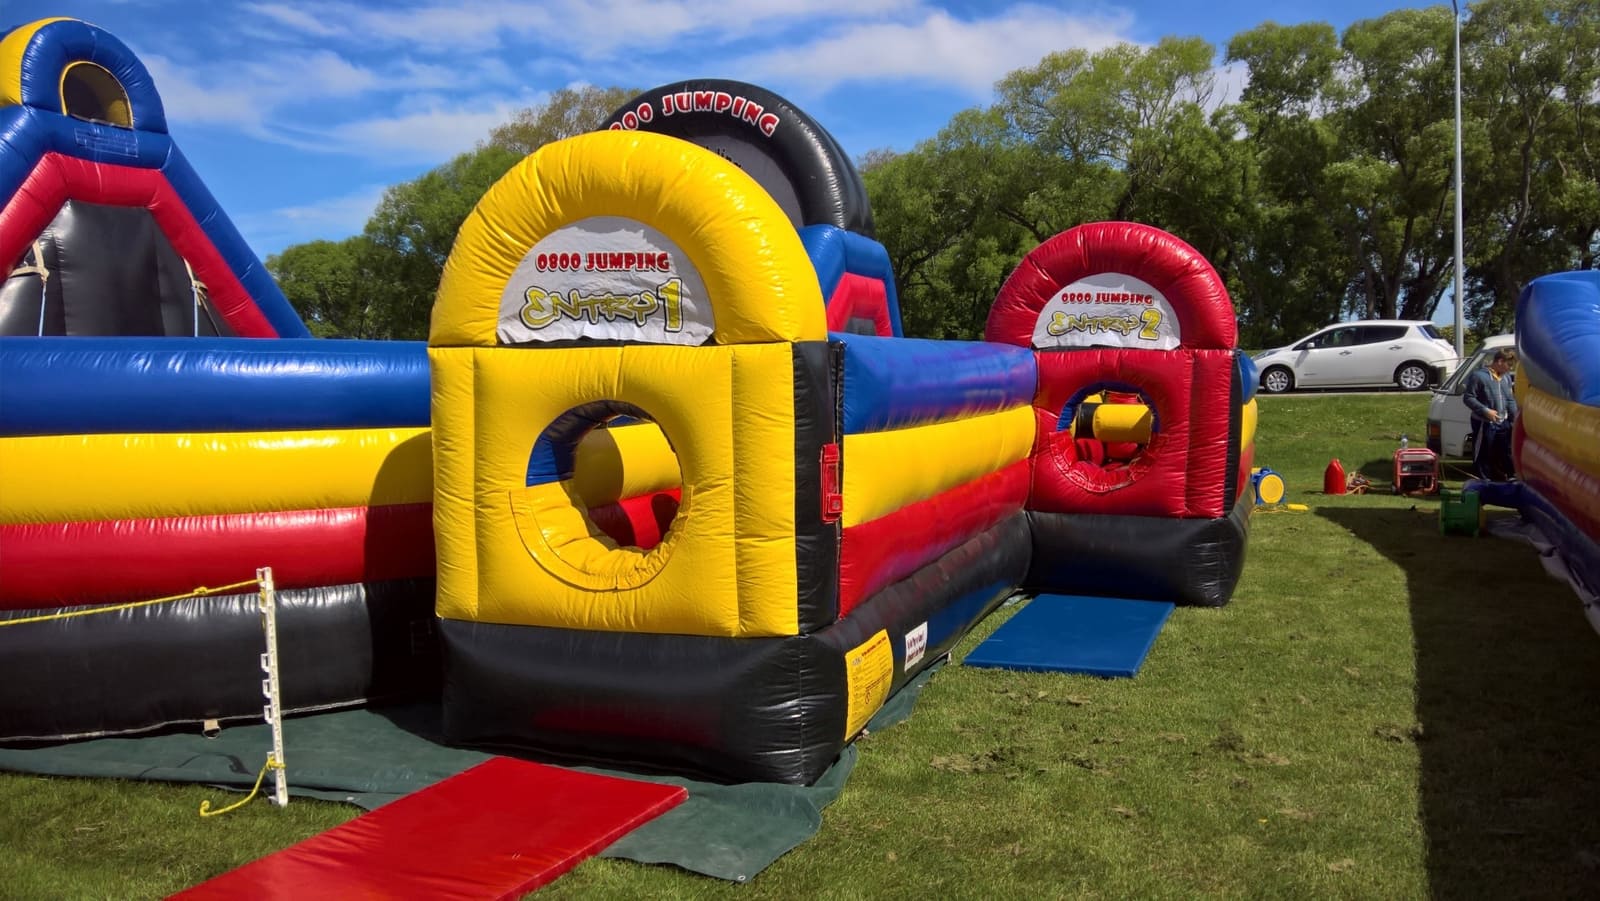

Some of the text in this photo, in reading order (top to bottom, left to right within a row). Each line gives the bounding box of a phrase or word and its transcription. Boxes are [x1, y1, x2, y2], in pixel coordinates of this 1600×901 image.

[662, 91, 780, 137] JUMPING
[537, 252, 670, 271] 0800 JUMPING
[520, 278, 683, 332] ENTRY 1
[1061, 292, 1154, 305] 0800 JUMPING
[1047, 308, 1162, 340] ENTRY 2
